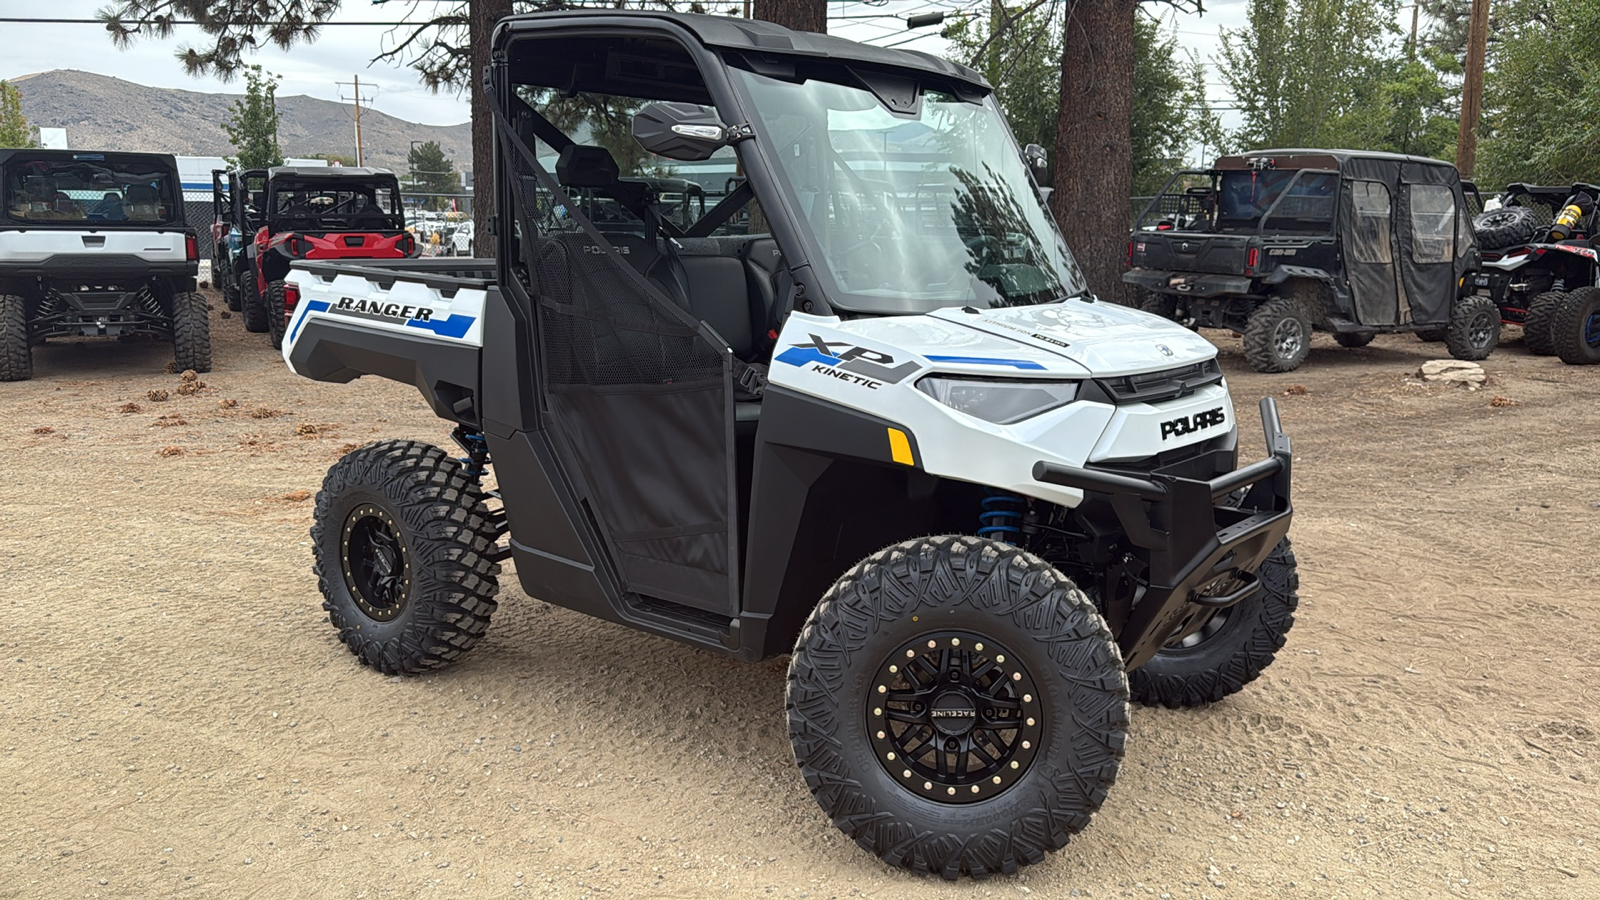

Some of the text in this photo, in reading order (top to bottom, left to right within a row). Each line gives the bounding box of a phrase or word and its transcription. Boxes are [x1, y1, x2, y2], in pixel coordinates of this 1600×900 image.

[583, 245, 630, 254] POLRIS
[337, 296, 434, 322] RANGER
[788, 332, 895, 364] XP
[812, 364, 882, 390] KINETIC
[1160, 405, 1226, 441] POLARIS
[931, 710, 976, 718] RACELINE
